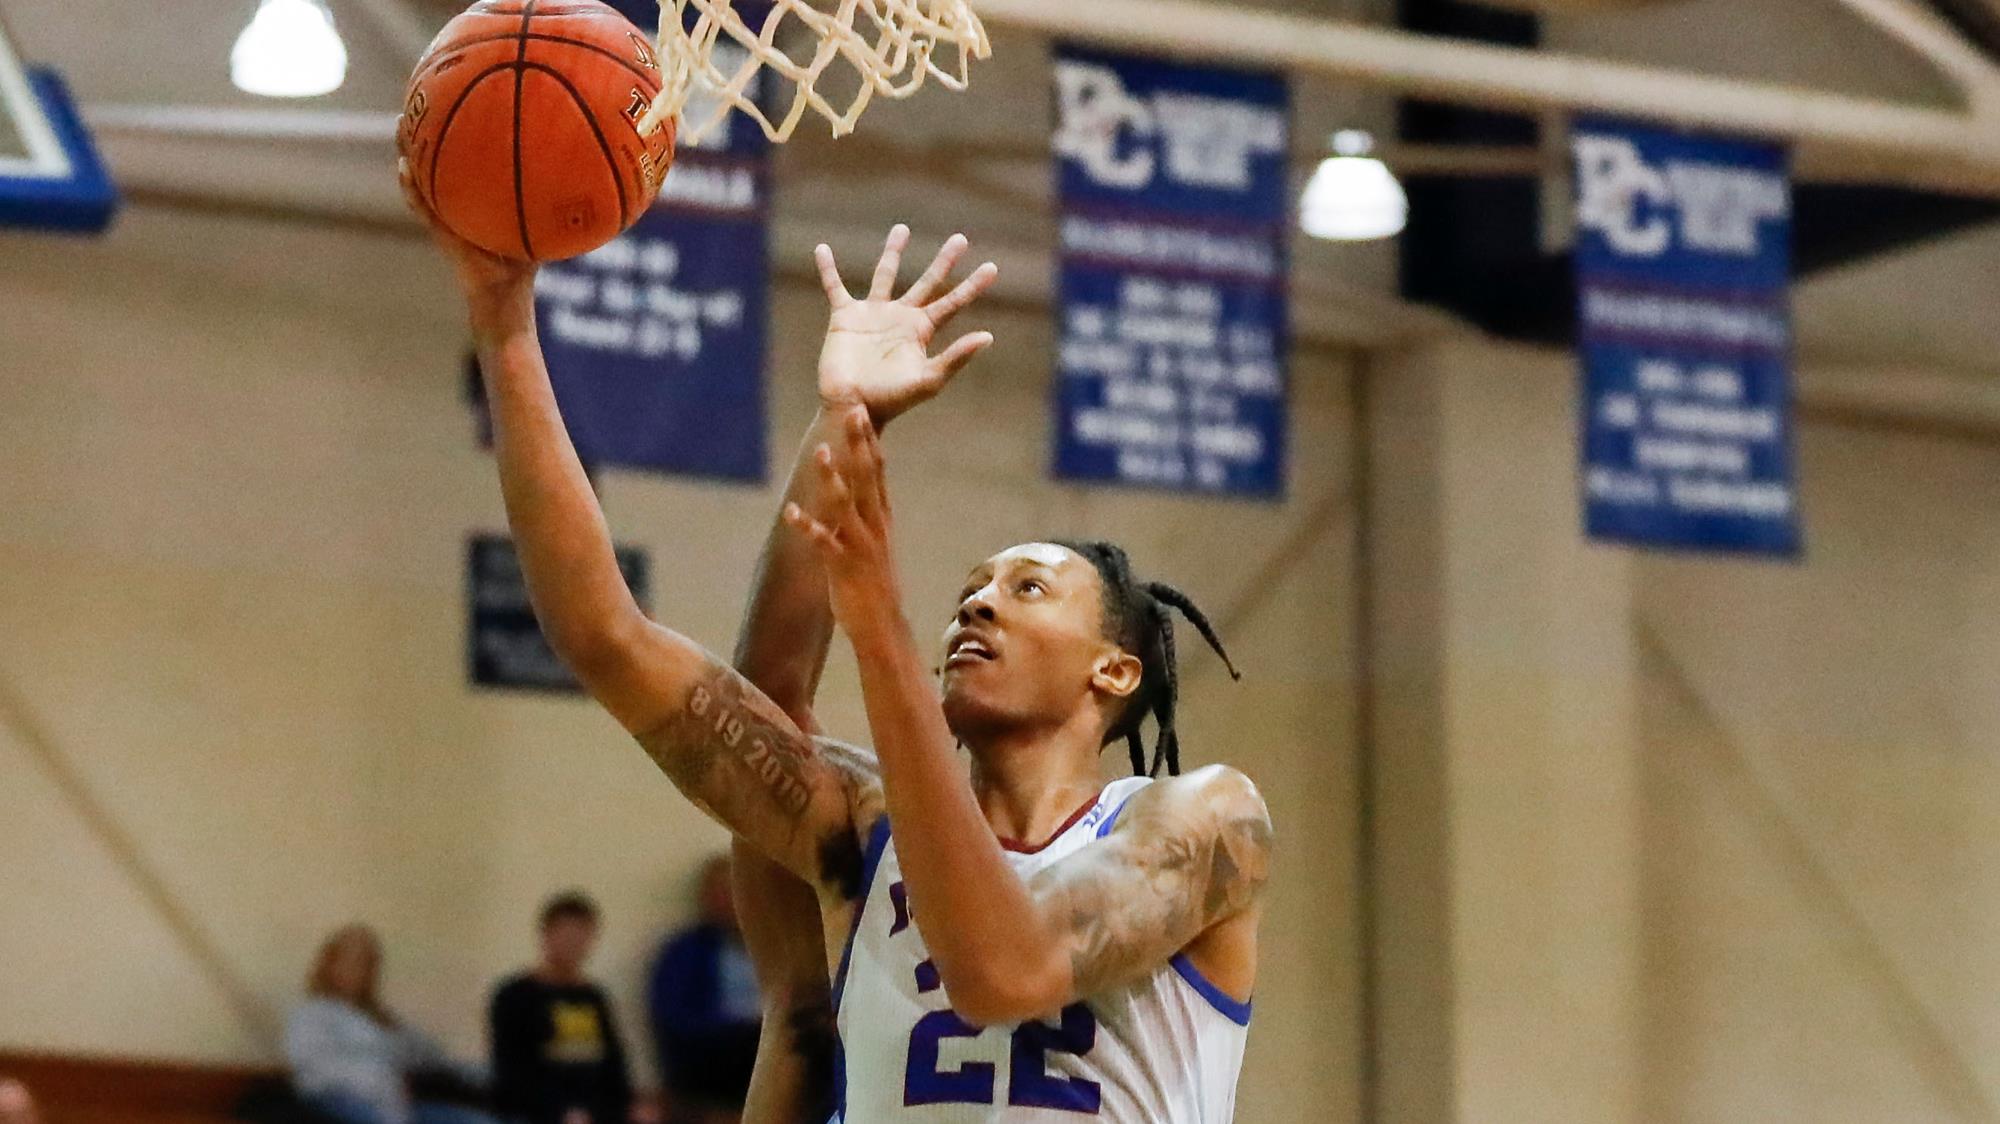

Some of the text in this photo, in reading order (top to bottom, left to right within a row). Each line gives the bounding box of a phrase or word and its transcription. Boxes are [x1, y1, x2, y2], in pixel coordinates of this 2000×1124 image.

[690, 686, 809, 813] 8 19 2019
[904, 1002, 1100, 1114] 22
